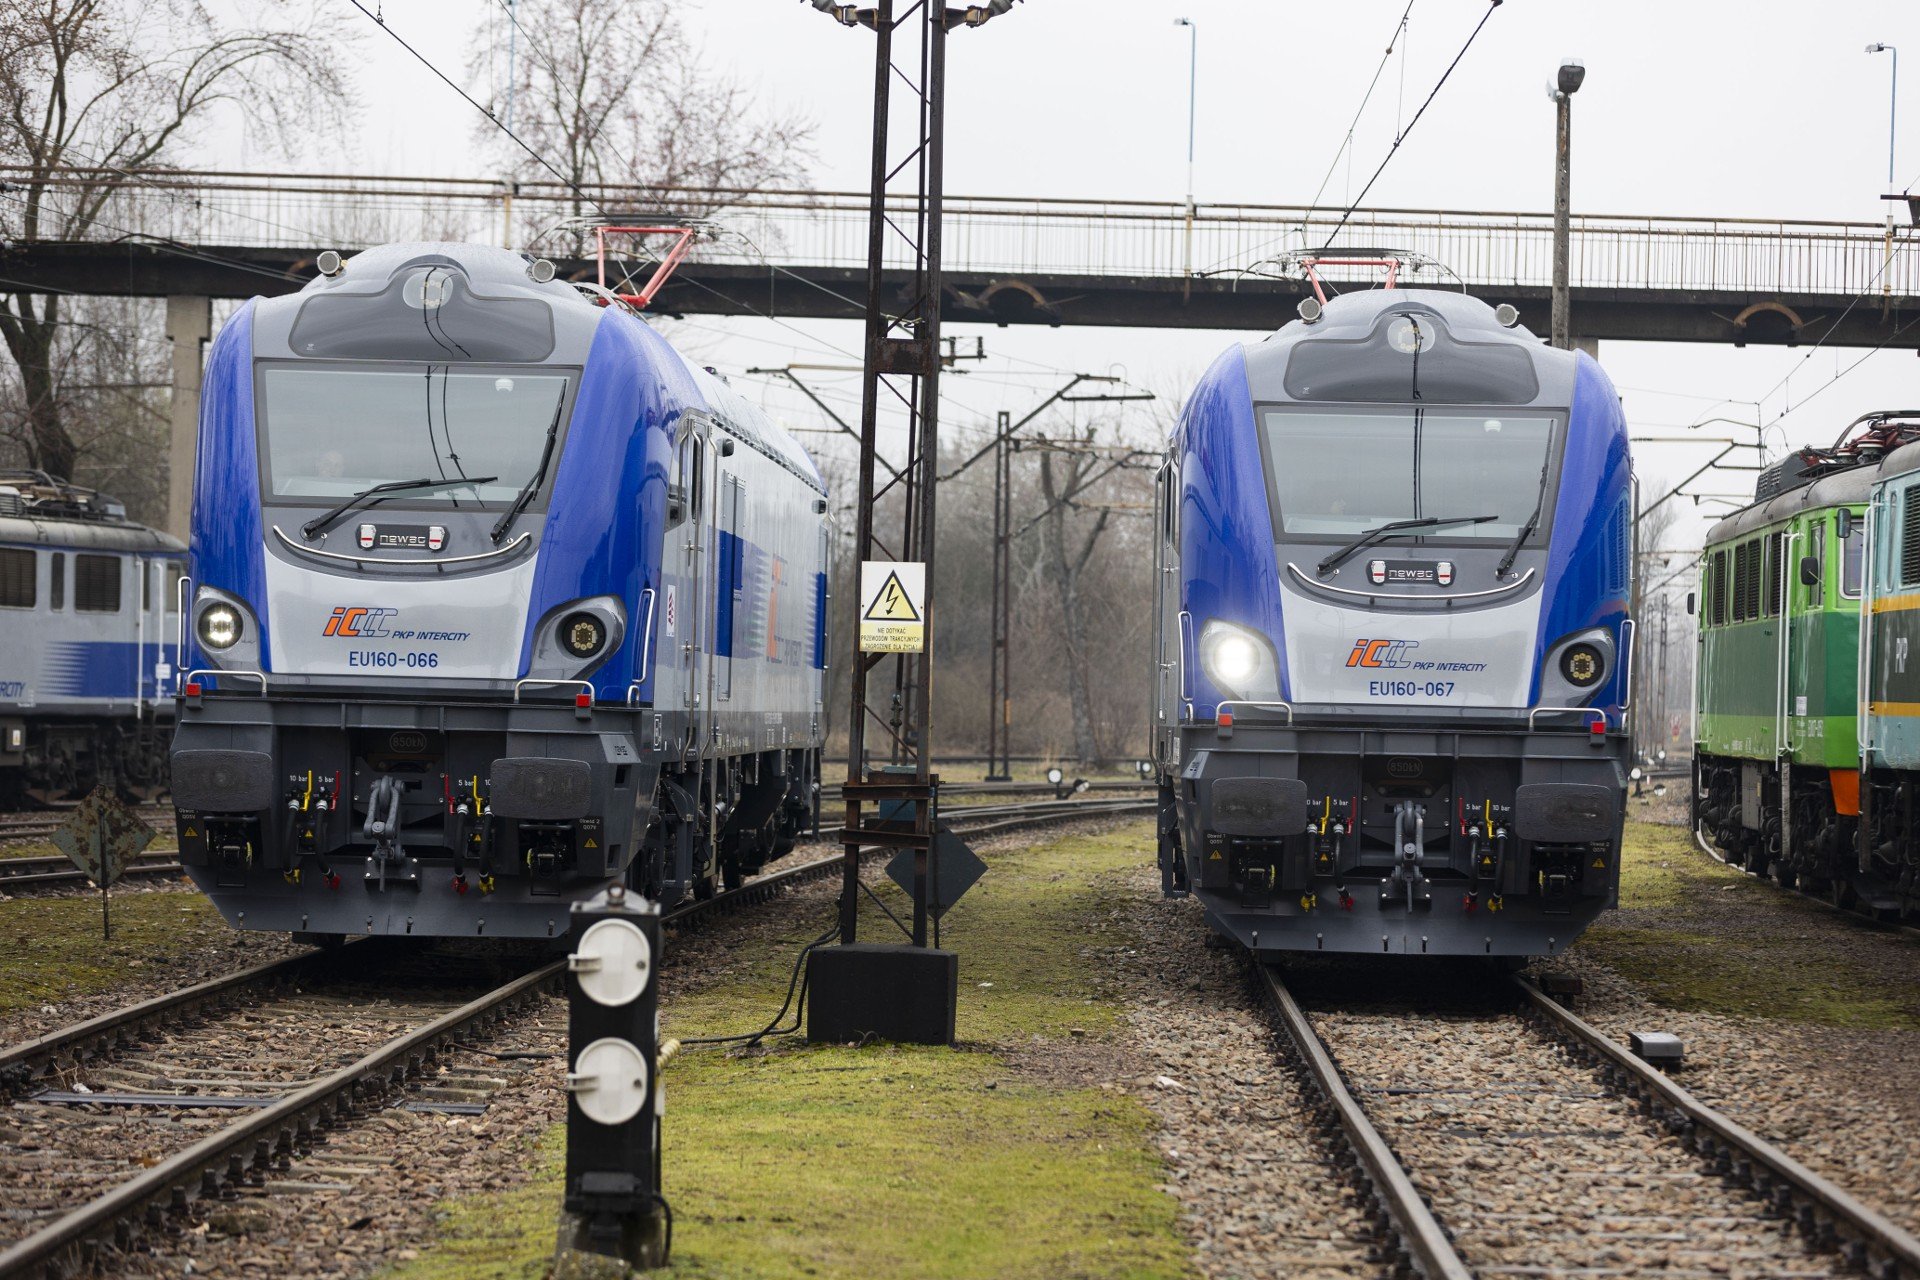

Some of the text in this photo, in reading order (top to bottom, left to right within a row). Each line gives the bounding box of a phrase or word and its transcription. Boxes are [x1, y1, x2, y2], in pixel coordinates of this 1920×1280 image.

[392, 630, 415, 639] PKP
[416, 631, 471, 641] INTERCITY
[349, 651, 438, 668] EU160-066
[1413, 661, 1435, 671] PKP
[1436, 662, 1488, 672] INTERCITY
[1369, 681, 1455, 697] EU160-067
